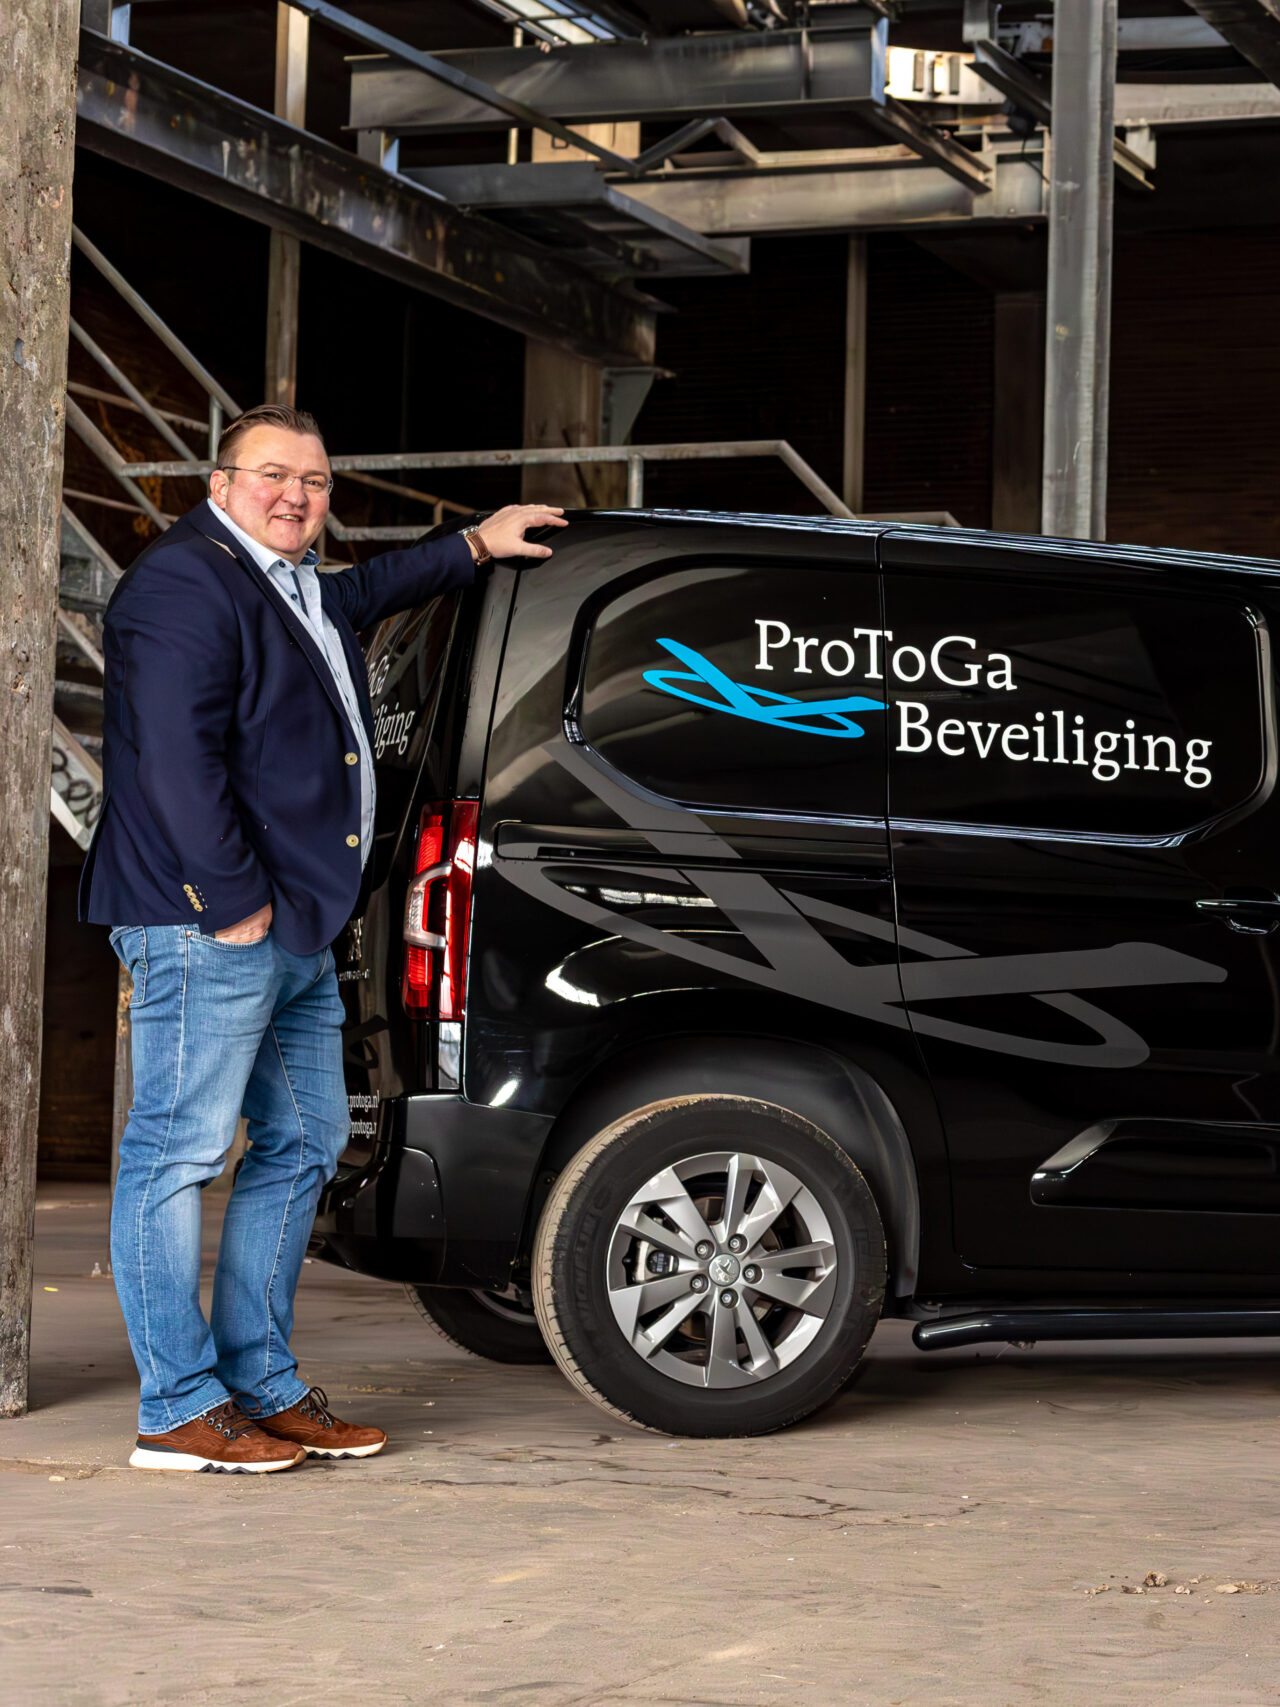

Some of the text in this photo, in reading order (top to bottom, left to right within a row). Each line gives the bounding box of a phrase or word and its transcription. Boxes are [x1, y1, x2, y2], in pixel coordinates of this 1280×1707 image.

[754, 618, 1018, 691] ProToGa
[374, 701, 416, 760] iliging
[895, 700, 1213, 789] Beveiliging
[346, 1089, 380, 1113] .protoga.nl
